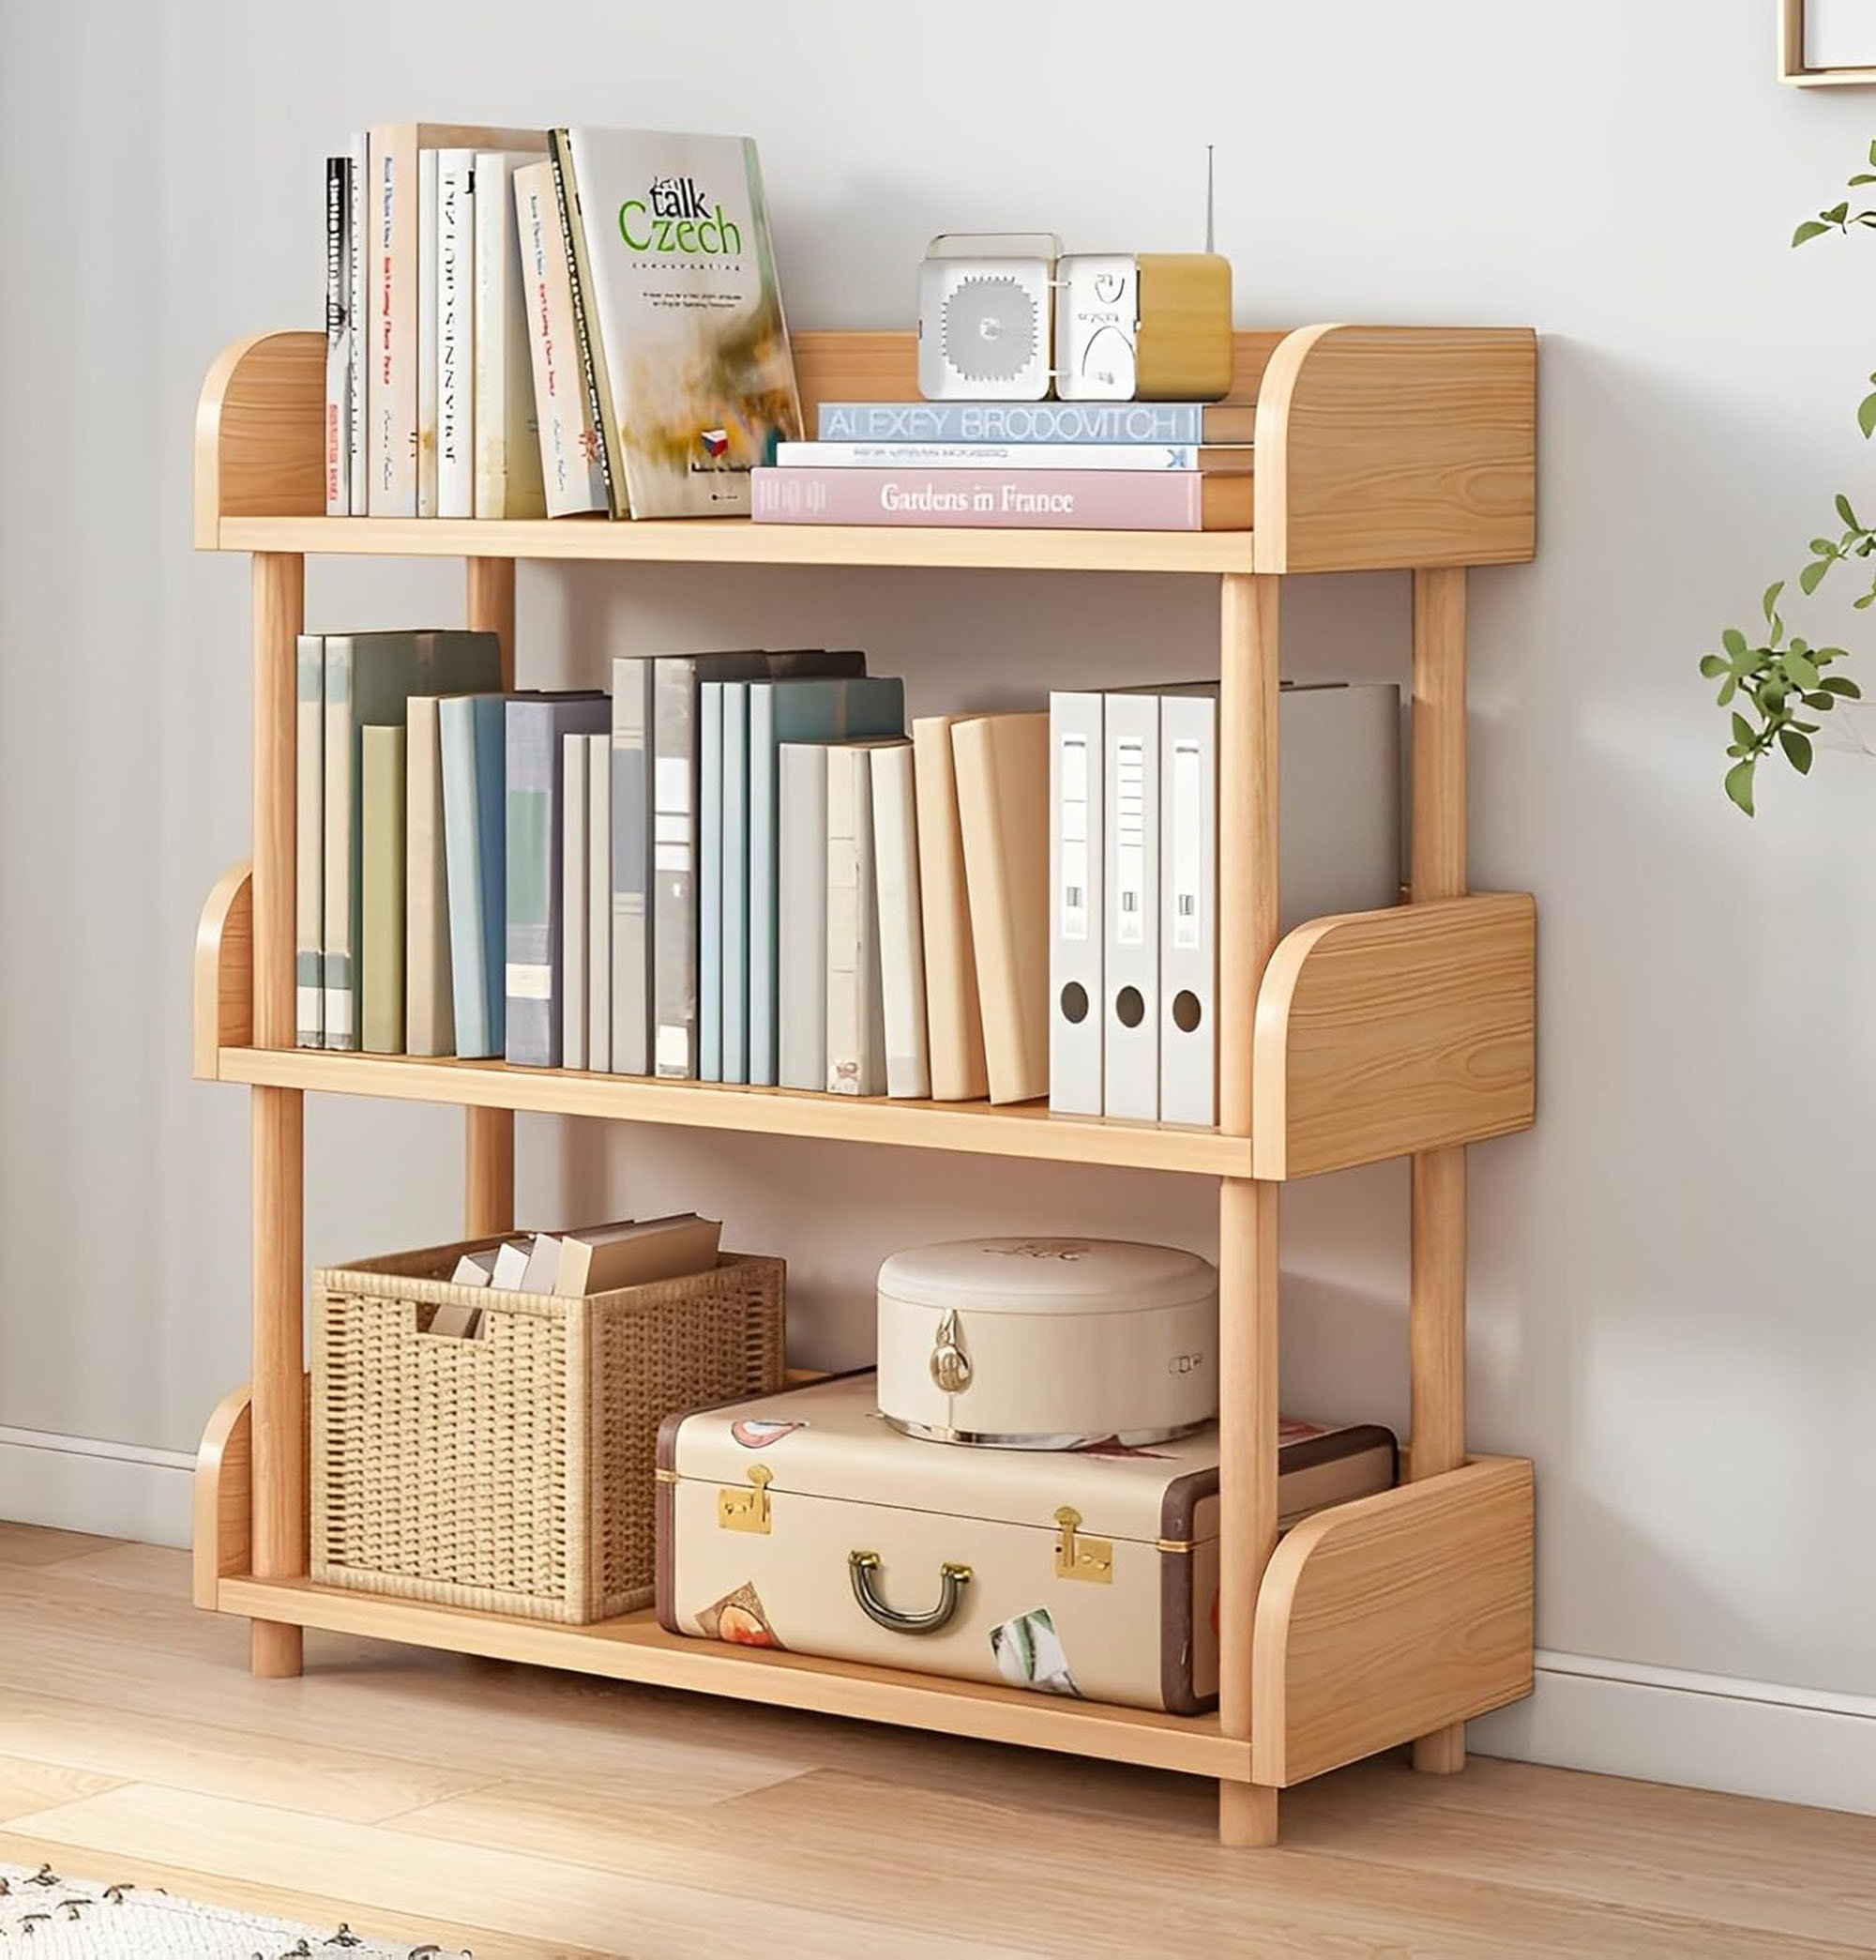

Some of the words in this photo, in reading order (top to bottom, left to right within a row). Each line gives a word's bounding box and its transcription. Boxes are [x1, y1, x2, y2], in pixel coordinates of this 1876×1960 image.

[649, 177, 712, 219] talk
[619, 200, 741, 254] Czech
[961, 408, 1176, 441] BRODOVITCH
[881, 482, 969, 512] Gardens
[973, 484, 994, 512] in
[1000, 484, 1074, 514] France
